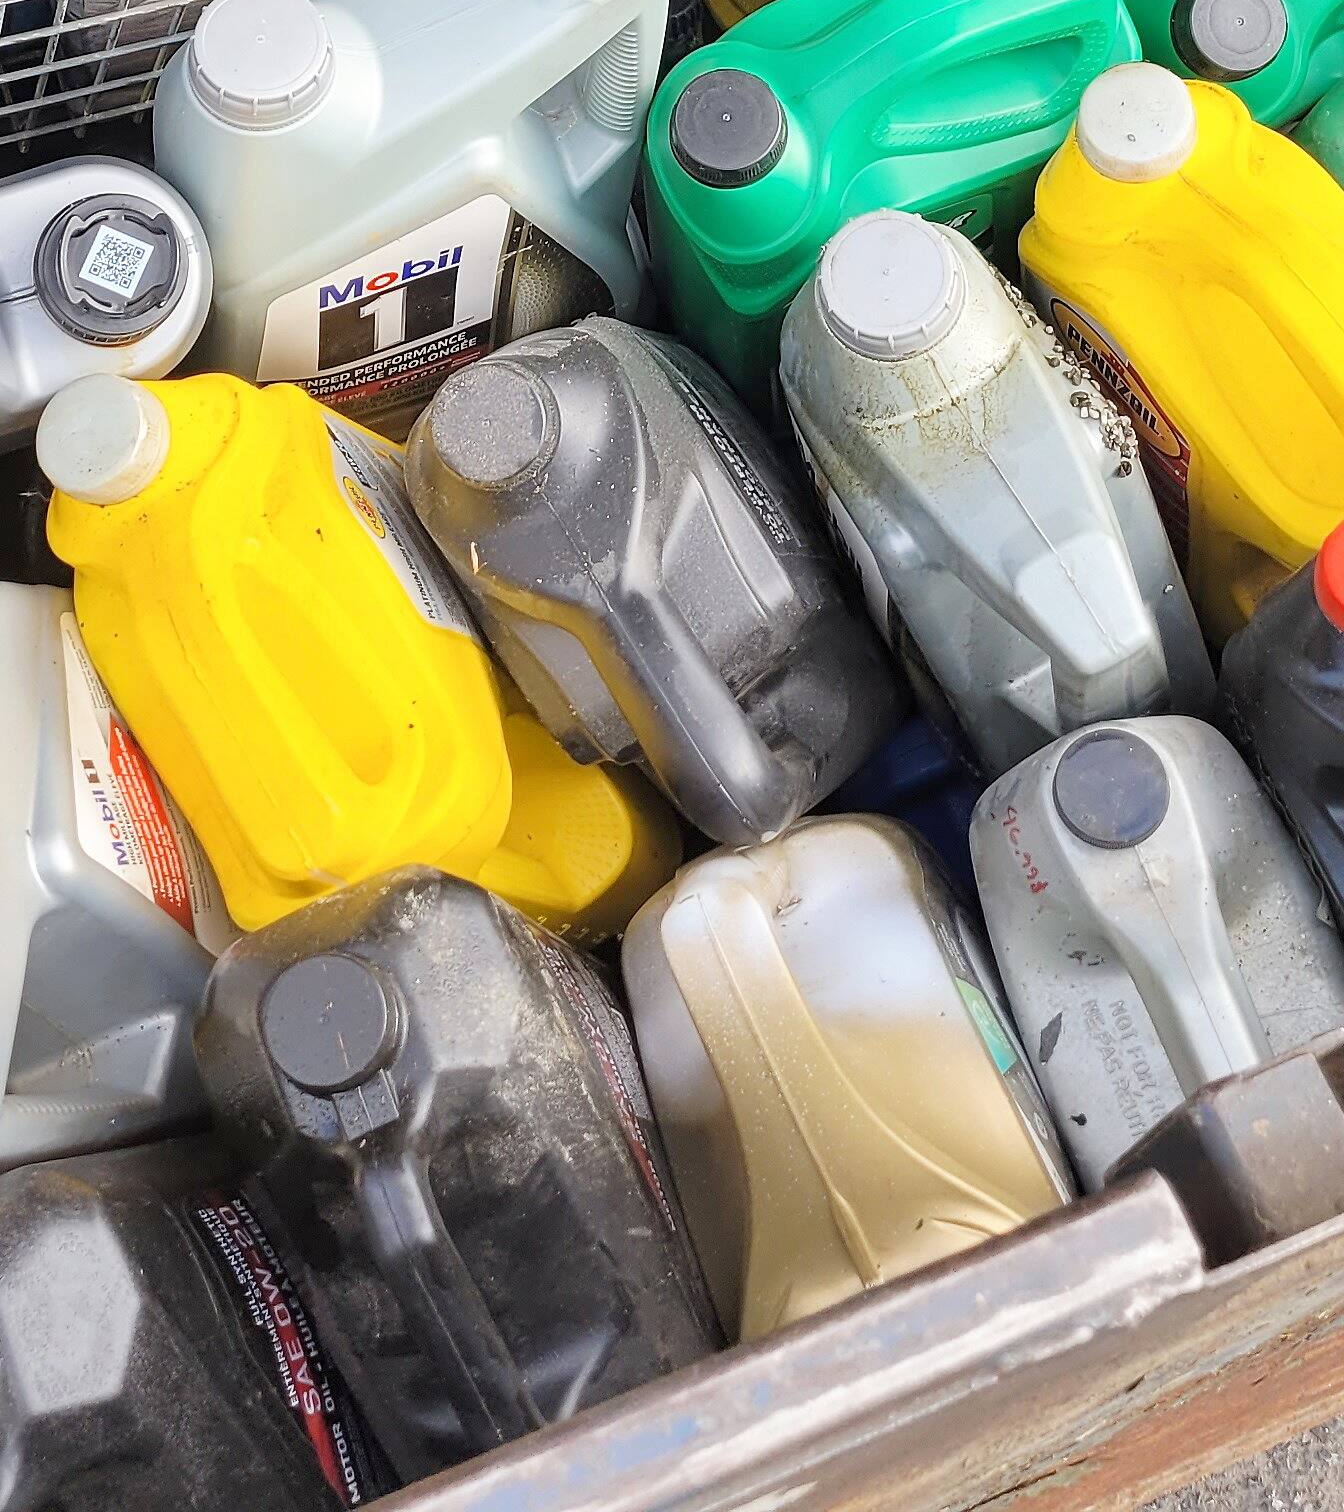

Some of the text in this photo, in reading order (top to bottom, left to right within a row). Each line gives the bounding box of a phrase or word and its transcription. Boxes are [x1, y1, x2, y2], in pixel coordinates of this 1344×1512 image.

[319, 245, 464, 309] Mobil
[359, 286, 407, 351] 1
[300, 372, 351, 389] ENDED
[354, 331, 467, 378] PERFORMANCE
[308, 370, 385, 397] ORMANCE
[388, 336, 477, 376] PROLONGÉE
[1067, 322, 1161, 436] PENNZOIL
[91, 789, 130, 866] Mobil
[1107, 999, 1137, 1042] NOT
[198, 1208, 264, 1326] FULL SYNTHETIC
[232, 1198, 285, 1277] MOTEUR
[218, 1205, 323, 1415] SAE 0W-20
[287, 1293, 319, 1356] HUILE
[319, 1375, 337, 1412] OIL
[333, 1422, 361, 1504] MOTOR
